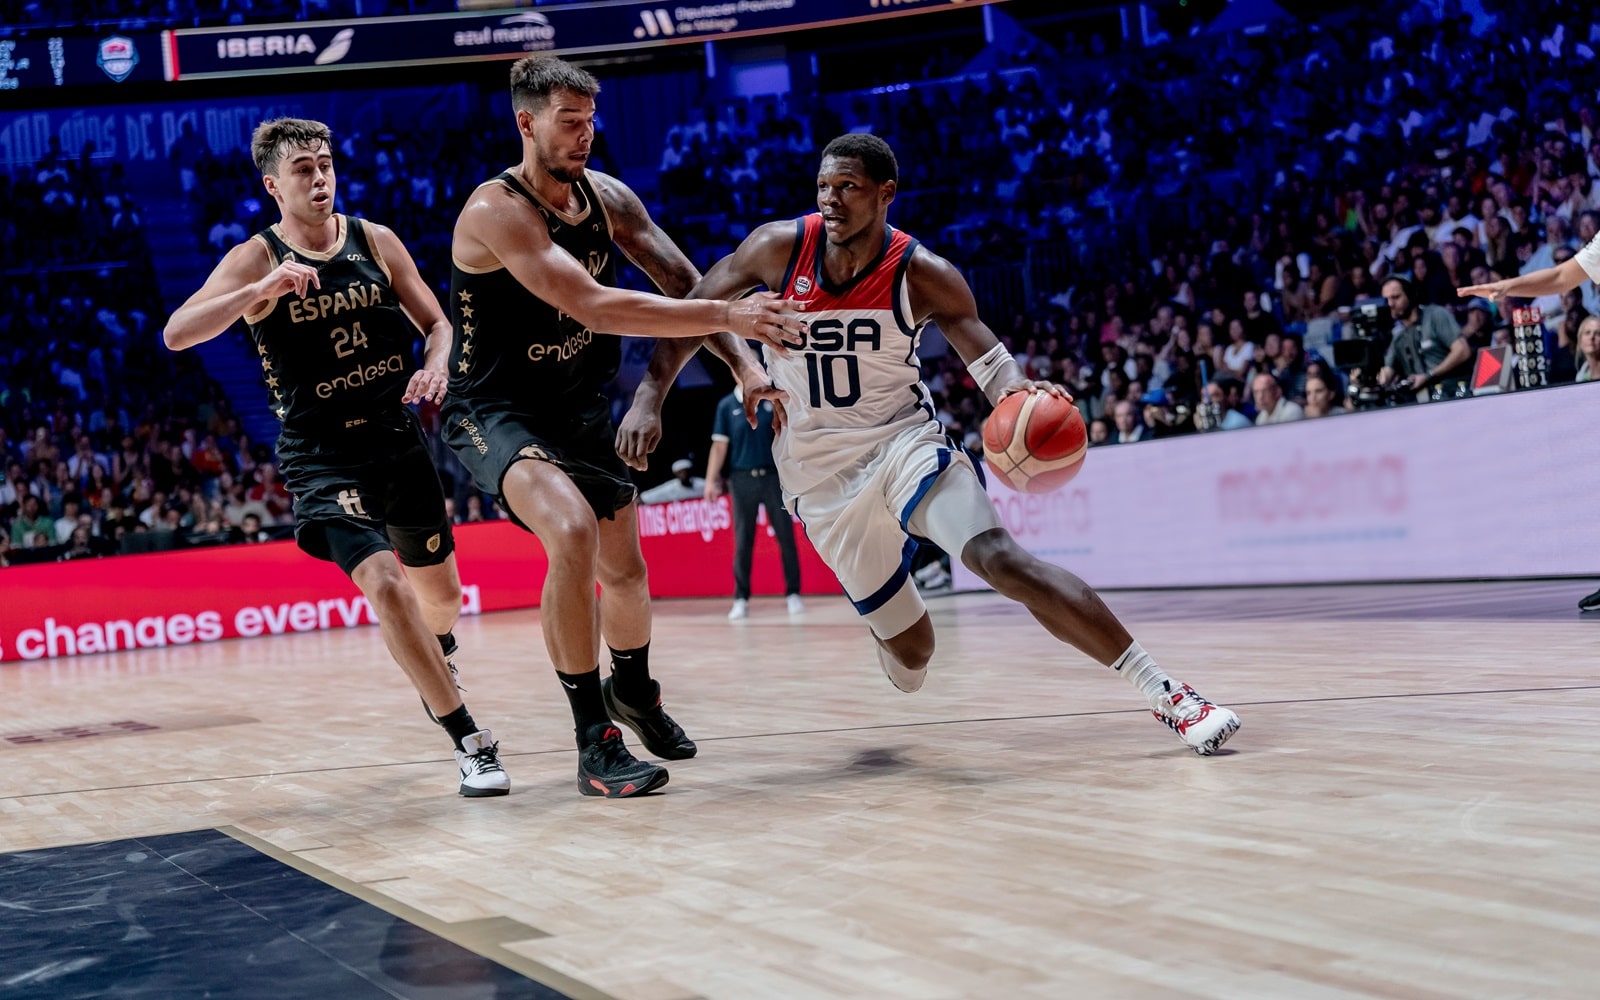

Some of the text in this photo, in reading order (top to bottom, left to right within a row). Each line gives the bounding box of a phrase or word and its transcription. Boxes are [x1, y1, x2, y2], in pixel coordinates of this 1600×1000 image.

[217, 35, 316, 59] IBERIA
[453, 24, 556, 46] azul marino
[289, 281, 382, 323] ESPAÑA
[330, 321, 368, 358] 24
[528, 328, 592, 362] endesa
[315, 354, 403, 399] endesa
[804, 353, 861, 408] 10
[460, 418, 489, 455] 923-2023
[1217, 448, 1407, 525] moderna
[15, 611, 223, 660] changes
